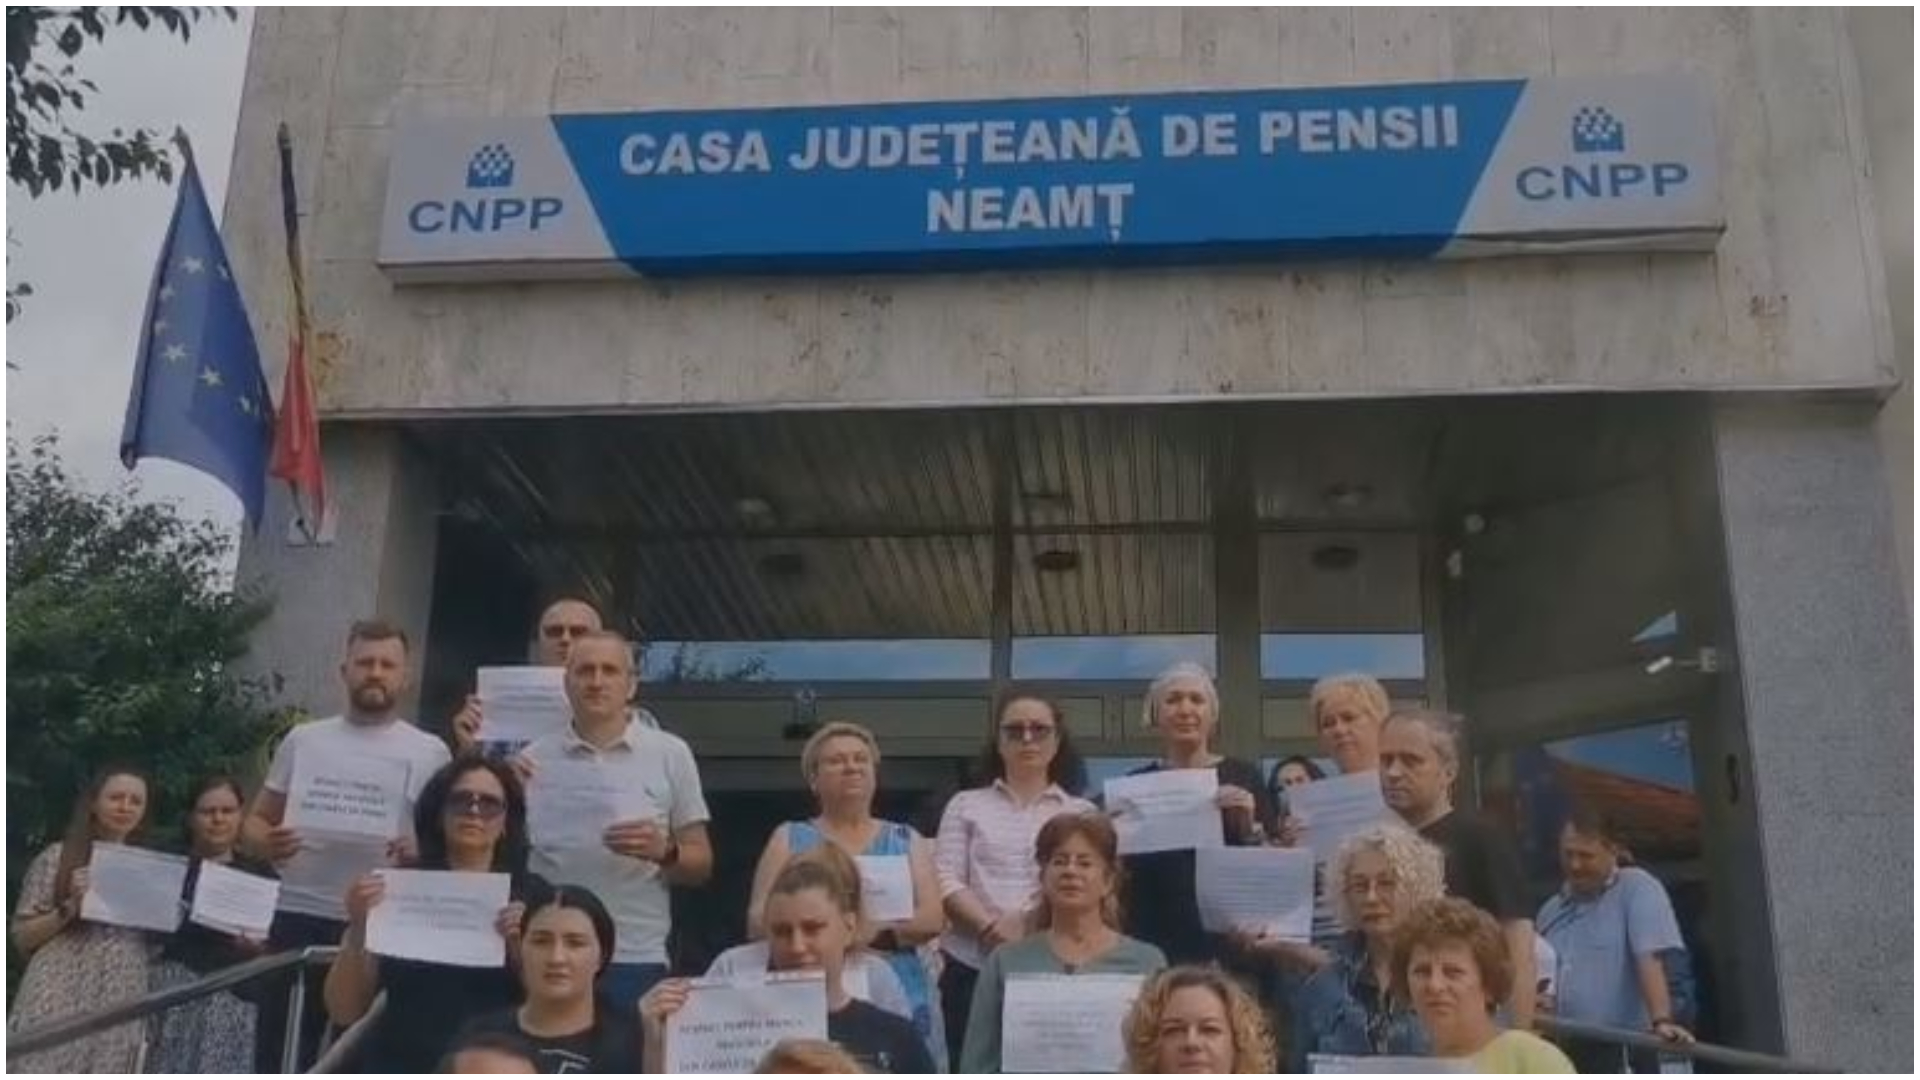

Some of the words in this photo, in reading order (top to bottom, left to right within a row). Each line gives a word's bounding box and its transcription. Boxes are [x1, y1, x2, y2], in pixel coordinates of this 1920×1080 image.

[619, 130, 772, 175] CASA
[789, 107, 1142, 179] JUDEȚEANĂ
[1162, 113, 1239, 157] DE
[1259, 105, 1459, 154] PENSII
[1515, 162, 1690, 201] CNPP
[408, 197, 564, 234] CNPP
[926, 183, 1134, 243] NEAMȚ
